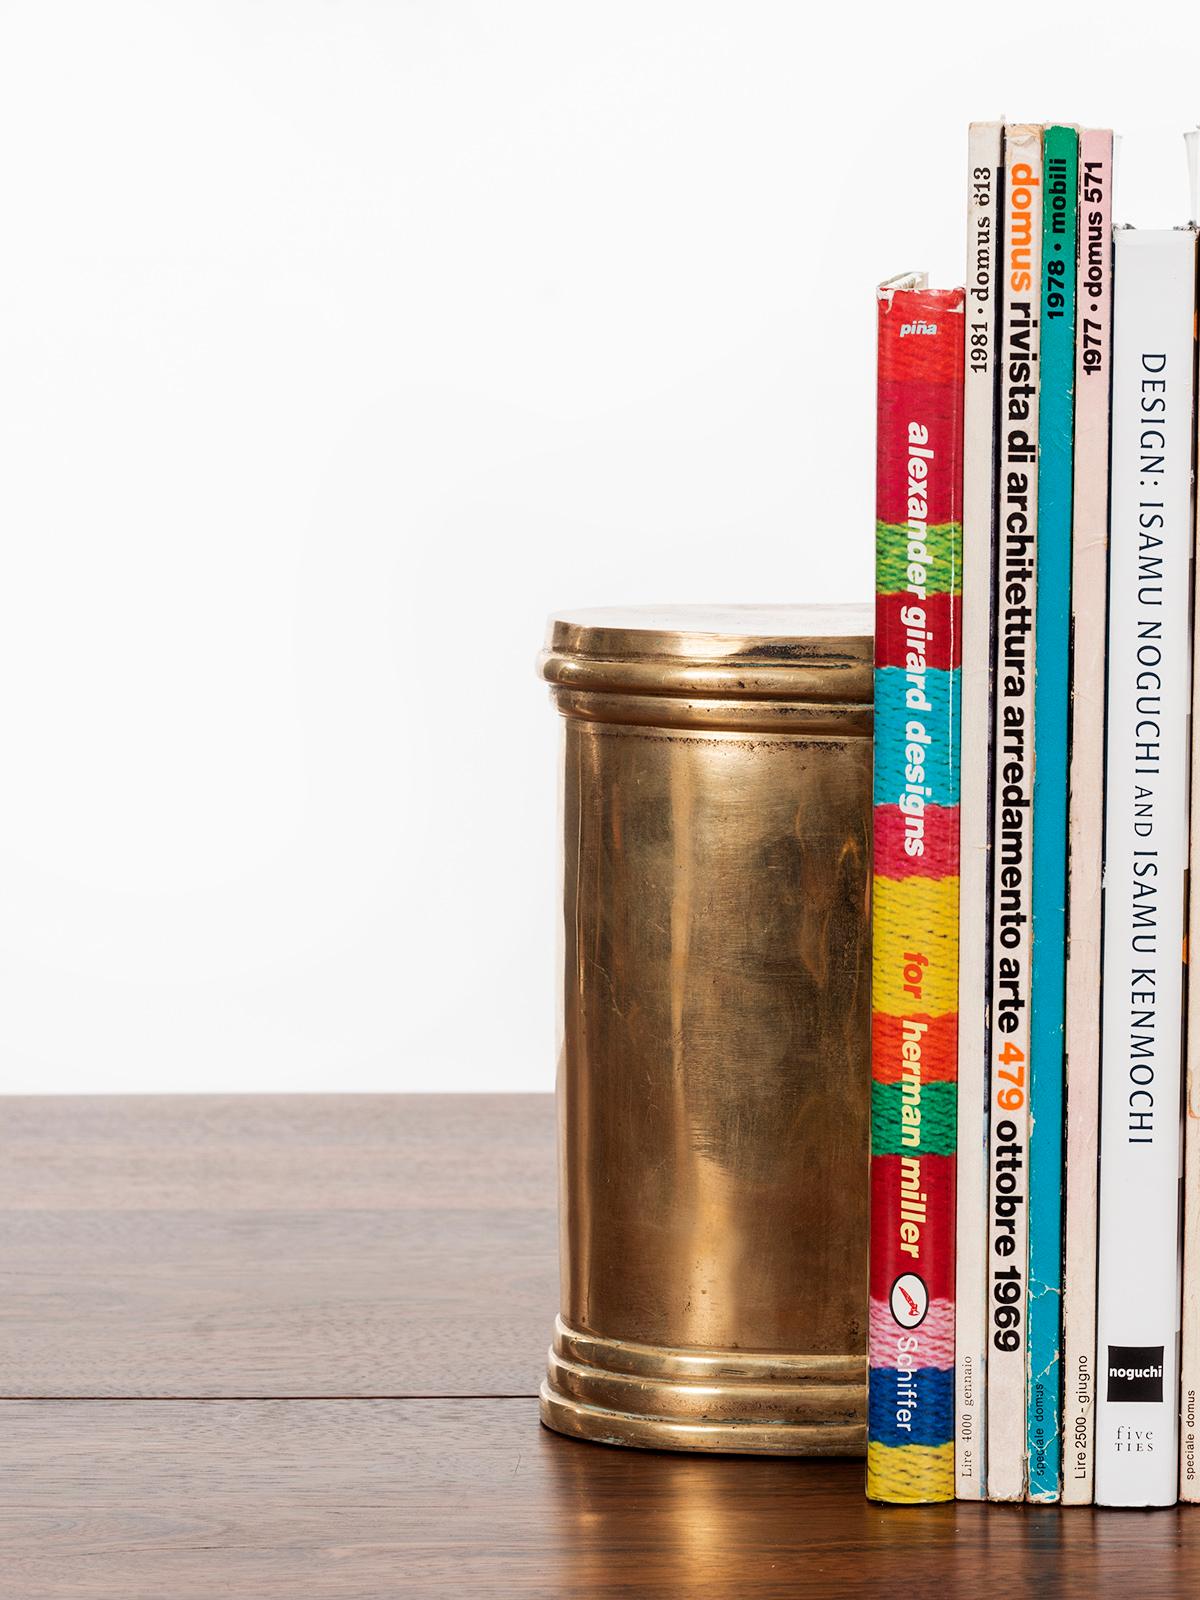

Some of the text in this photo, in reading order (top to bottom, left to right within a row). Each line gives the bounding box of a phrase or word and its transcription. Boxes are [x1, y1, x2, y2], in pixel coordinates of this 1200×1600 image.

[1049, 159, 1066, 233] mobili
[1084, 162, 1103, 203] 571
[971, 216, 990, 301] domus
[1084, 211, 1103, 297] domus
[1047, 260, 1065, 320] 1978
[900, 320, 937, 337] piña
[971, 322, 988, 373] 1981
[1083, 318, 1102, 376] 1977
[994, 163, 1039, 1352] domus rivista di architettura arredamento arte 479 ottobre 1969
[1128, 354, 1166, 1143] DESIGN: ISAMU NOGUCHI AND ISAMU KENMOCHI
[899, 422, 934, 1260] alexander girard designs for herman miller
[896, 1336, 918, 1432] Schiffer
[1076, 1355, 1090, 1403] giugno
[1110, 1366, 1162, 1380] noguchi
[962, 1356, 974, 1477] Lire 4000 gennaio
[1035, 1384, 1046, 1476] speciale domus
[1075, 1416, 1086, 1448] 2500
[1117, 1426, 1153, 1440] five
[1185, 1390, 1196, 1480] speciale domus
[1075, 1453, 1086, 1479] Lire
[1114, 1442, 1153, 1452] TIES
